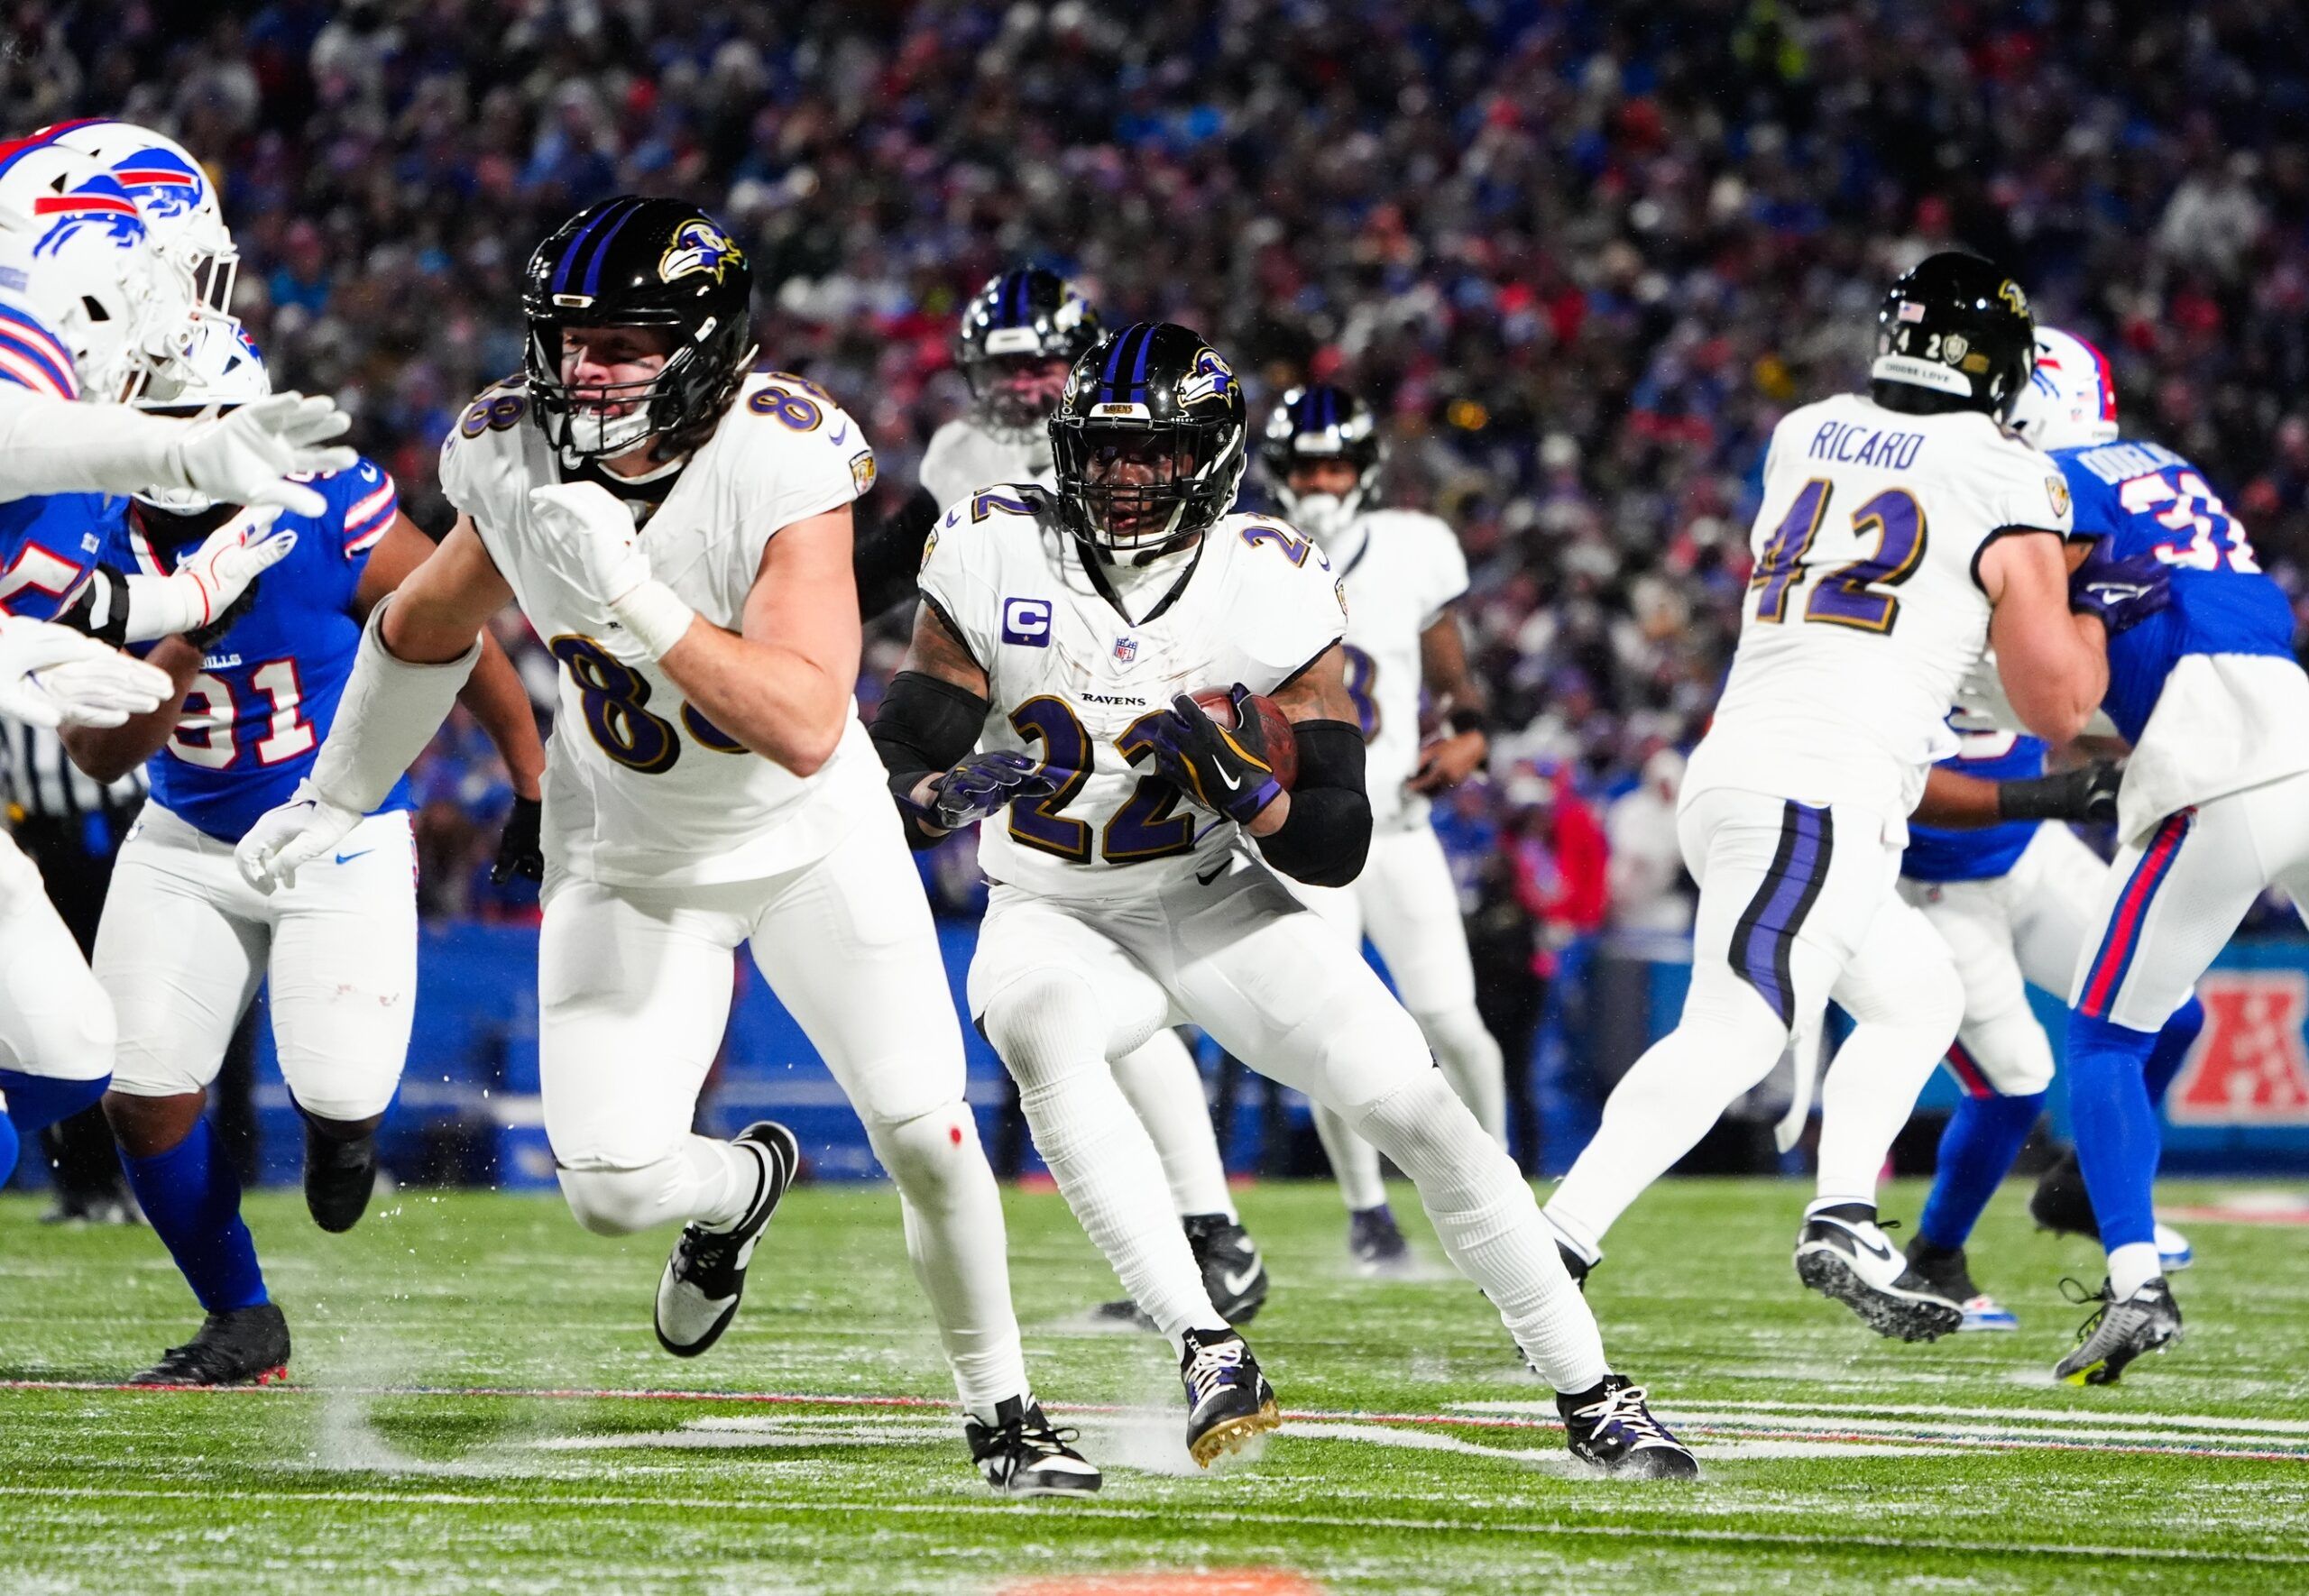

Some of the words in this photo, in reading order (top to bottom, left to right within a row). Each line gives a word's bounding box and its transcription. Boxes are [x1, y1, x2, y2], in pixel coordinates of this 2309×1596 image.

[1926, 333, 1941, 359] 2
[1922, 369, 1951, 383] LOVE
[1102, 404, 1133, 415] RAVENS
[1808, 420, 1926, 471] RICARD
[1752, 477, 1928, 637] 42
[1006, 601, 1049, 636] C
[1116, 647, 1133, 660] NFL
[165, 656, 317, 772] 91
[1081, 693, 1146, 706] RAVENS
[1007, 693, 1195, 865] 22
